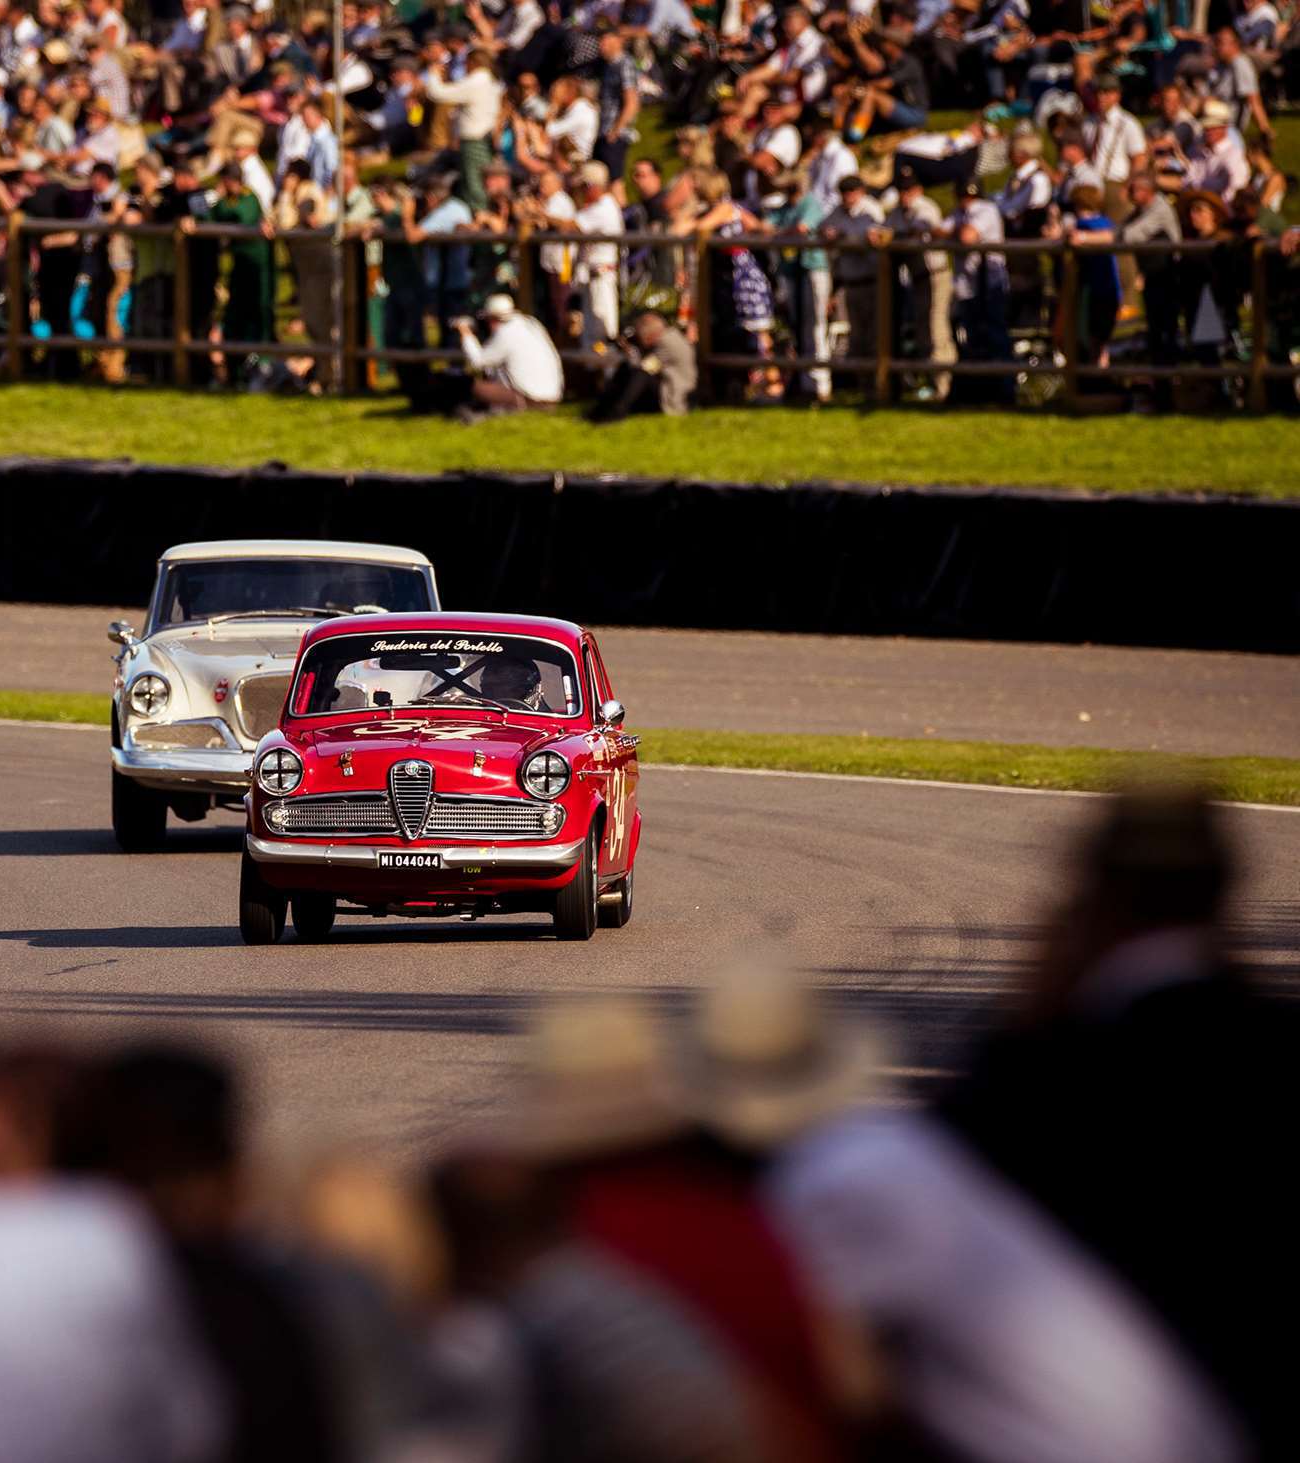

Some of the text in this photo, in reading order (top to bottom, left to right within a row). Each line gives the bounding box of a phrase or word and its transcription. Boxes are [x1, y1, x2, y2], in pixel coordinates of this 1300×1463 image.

[371, 640, 504, 652] Scuderia del Portello
[381, 855, 439, 867] MI 044044
